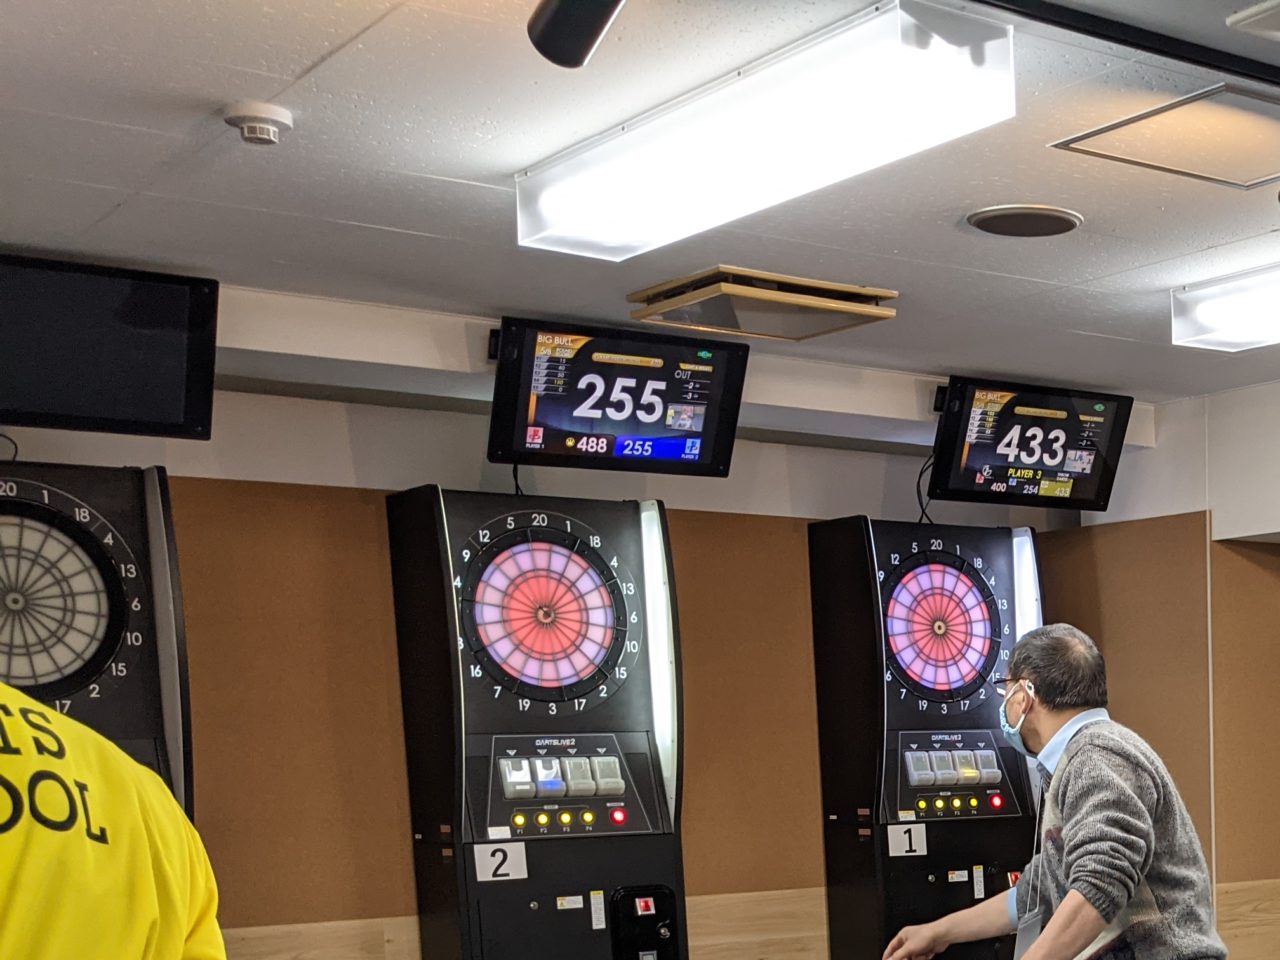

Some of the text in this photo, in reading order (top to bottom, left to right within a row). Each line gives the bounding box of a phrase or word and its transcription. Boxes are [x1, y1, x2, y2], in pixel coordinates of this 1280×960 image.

[538, 335, 573, 346] BIG BULL
[674, 370, 691, 379] OUT
[573, 374, 667, 423] 255
[577, 436, 607, 453] 488
[623, 440, 652, 455] 255
[996, 424, 1066, 467] 433
[1008, 468, 1042, 479] PLAYER 3
[0, 482, 17, 496] 20
[990, 482, 1007, 492] 400
[1022, 485, 1039, 494] 254
[1055, 487, 1071, 497] 433
[42, 490, 49, 504] 1
[75, 508, 90, 522] 18
[532, 514, 547, 526] 20
[507, 517, 515, 529] 5
[566, 521, 571, 532] 1
[104, 532, 113, 546] 4
[479, 530, 490, 542] 12
[590, 536, 601, 547] 18
[912, 542, 918, 553] 5
[930, 539, 943, 550] 20
[956, 545, 960, 555] 1
[462, 550, 470, 561] 9
[891, 554, 900, 565] 12
[611, 556, 618, 568] 4
[974, 558, 983, 569] 18
[120, 564, 137, 578] 13
[878, 572, 885, 582] 9
[989, 577, 996, 586] 4
[623, 584, 634, 594] 13
[132, 598, 141, 611] 6
[999, 600, 1008, 610] 13
[630, 612, 638, 622] 6
[1003, 625, 1010, 634] 6
[126, 632, 142, 646] 10
[627, 642, 638, 652] 10
[1000, 650, 1010, 660] 10
[111, 663, 127, 676] 15
[470, 665, 482, 677] 16
[615, 667, 627, 678] 15
[90, 684, 100, 698] 2
[494, 686, 502, 698] 7
[599, 686, 607, 697] 2
[900, 689, 907, 699] 7
[979, 689, 986, 699] 2
[56, 701, 72, 713] 17
[518, 700, 530, 711] 19
[549, 703, 557, 714] 3
[574, 700, 586, 710] 17
[918, 701, 928, 711] 19
[941, 704, 948, 714] 3
[960, 701, 970, 711] 17
[535, 738, 576, 746] DARTSLIVE2
[903, 828, 917, 853] 1
[490, 848, 511, 878] 2
